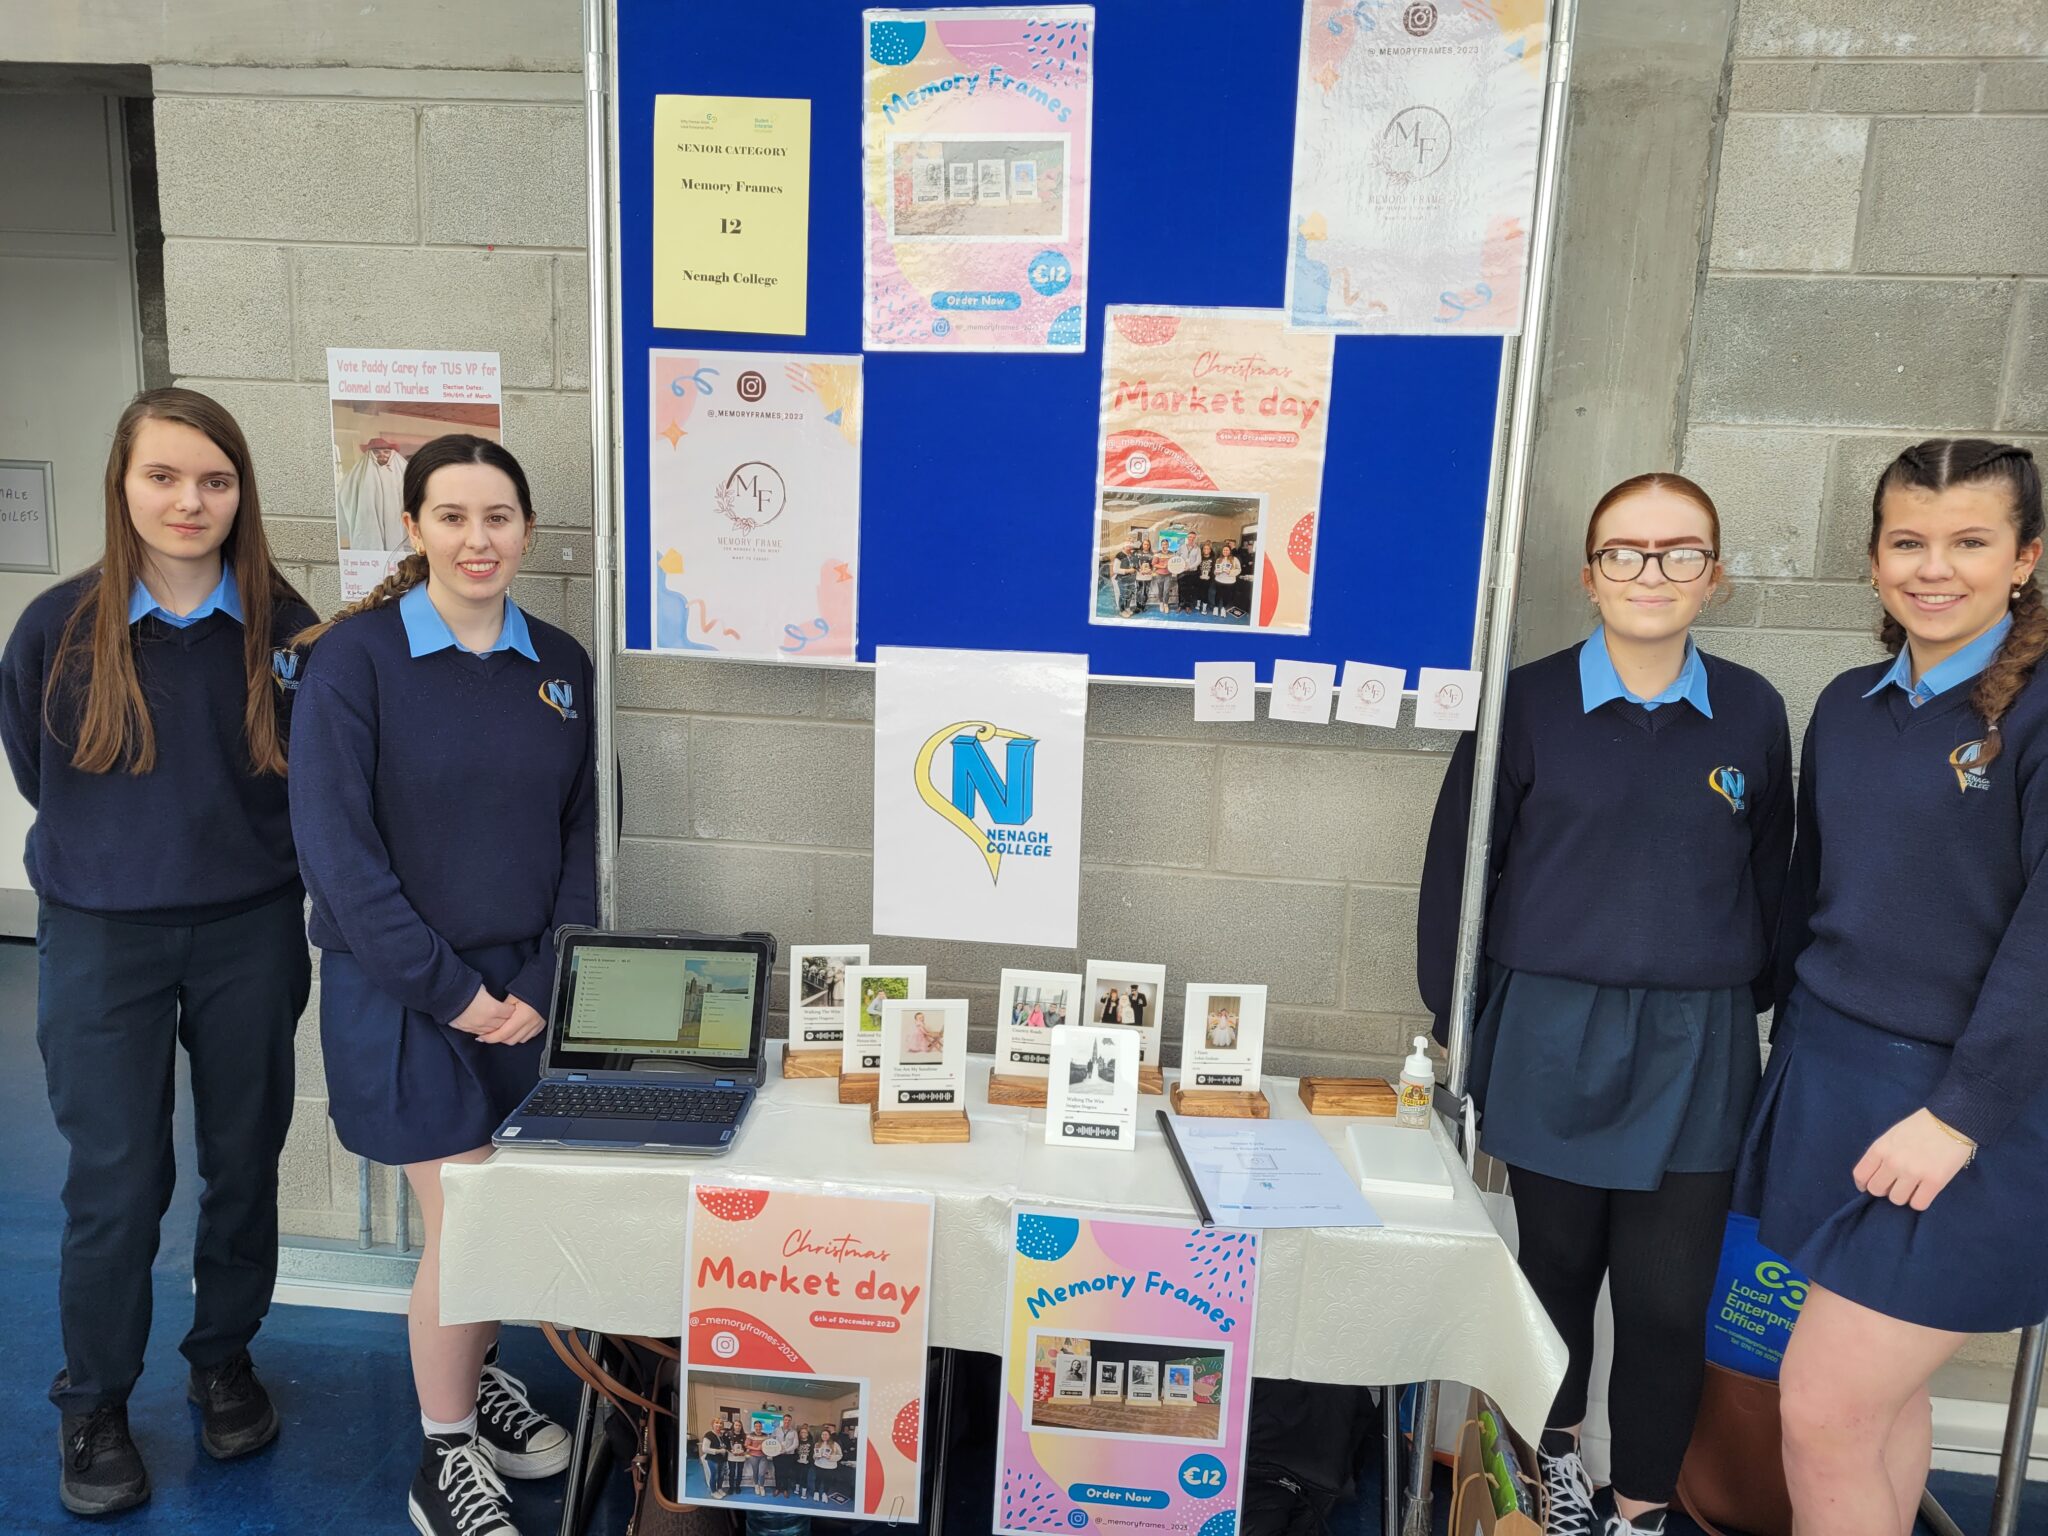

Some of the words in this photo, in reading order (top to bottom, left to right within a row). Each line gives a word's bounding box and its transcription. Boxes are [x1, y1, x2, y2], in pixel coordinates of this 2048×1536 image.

[882, 73, 980, 125] Memory
[989, 65, 1073, 123] Frames
[677, 143, 722, 154] SENIOR
[725, 146, 788, 157] CATEGORY
[681, 178, 733, 194] Memory
[736, 181, 783, 194] Frames
[720, 218, 742, 234] 12
[682, 270, 729, 285] Nenagh
[733, 272, 778, 287] College
[1032, 264, 1067, 284] €12
[947, 294, 978, 306] Order
[981, 294, 1006, 305] Now
[337, 360, 358, 373] Vote
[361, 360, 388, 376] Paddy
[391, 361, 418, 377] Carey
[422, 361, 437, 374] for
[440, 362, 462, 375] TUS
[465, 363, 478, 375] VP
[481, 363, 497, 376] for
[1192, 351, 1293, 382] Christmas
[338, 380, 372, 394] Clonmel
[375, 381, 391, 394] and
[394, 382, 430, 395] Thurles
[1114, 378, 1246, 413] Market
[1259, 386, 1320, 429] day
[736, 474, 773, 512] MF
[987, 828, 1048, 843] NENAGH
[986, 842, 1053, 857] COLLEGE
[782, 1229, 891, 1264] Christmas
[697, 1256, 841, 1297] Market
[855, 1270, 921, 1315] day
[1731, 1279, 1774, 1305] Local
[1026, 1273, 1136, 1320] Memory
[1145, 1271, 1236, 1333] Frames
[814, 1315, 827, 1323] 6th
[838, 1317, 874, 1327] December
[876, 1319, 896, 1328] 2023
[1720, 1306, 1765, 1335] Office
[1726, 1292, 1797, 1333] Enterpris
[1183, 1466, 1222, 1486] €12
[1086, 1487, 1122, 1500] Order
[1125, 1491, 1152, 1503] Now
[1094, 1516, 1189, 1532] @_memoryframes_2023
